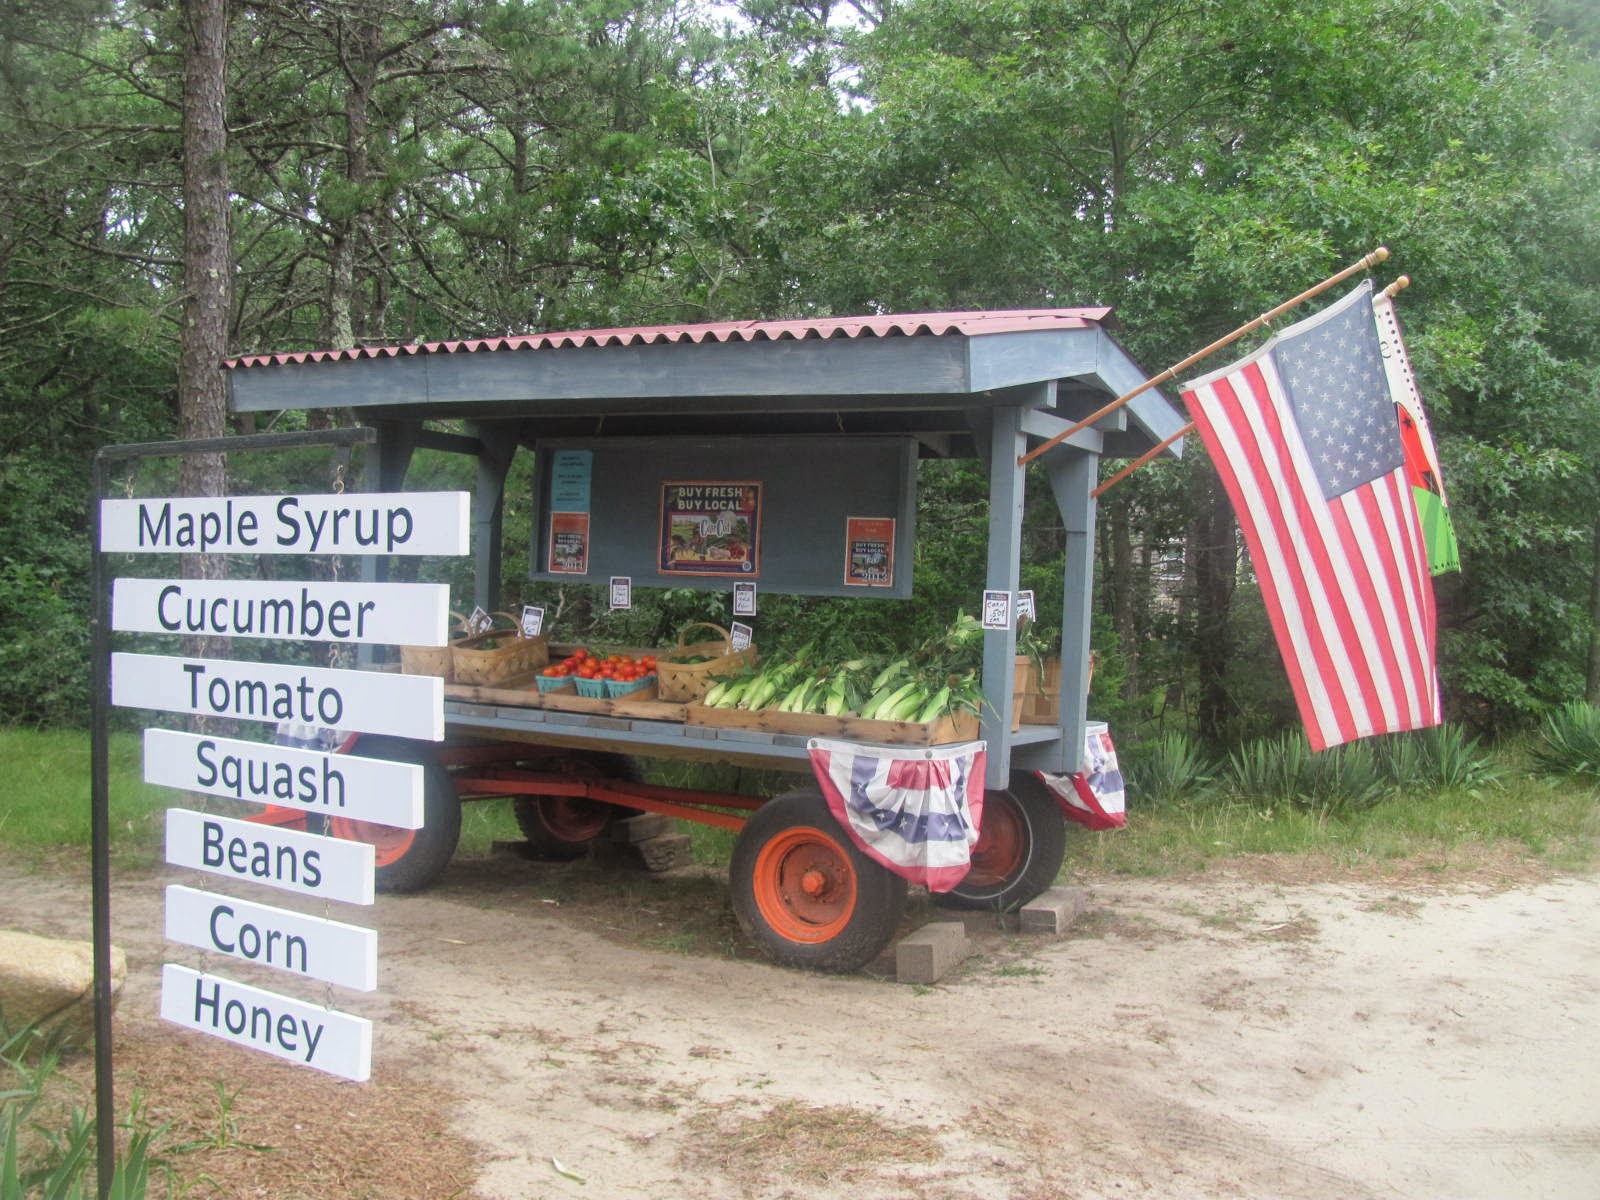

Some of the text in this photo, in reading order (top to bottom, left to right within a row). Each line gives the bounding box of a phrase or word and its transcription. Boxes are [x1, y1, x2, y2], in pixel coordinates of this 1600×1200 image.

[677, 500, 743, 511] BUY LOCAL
[678, 487, 743, 497] BUY FRESH
[138, 496, 414, 553] Maple Syrup
[156, 584, 376, 639] Cucumber
[182, 663, 344, 726] Tomato
[196, 740, 346, 808] Squash
[202, 821, 323, 888] Beans
[209, 905, 308, 973] Corn
[193, 978, 325, 1063] Honey
